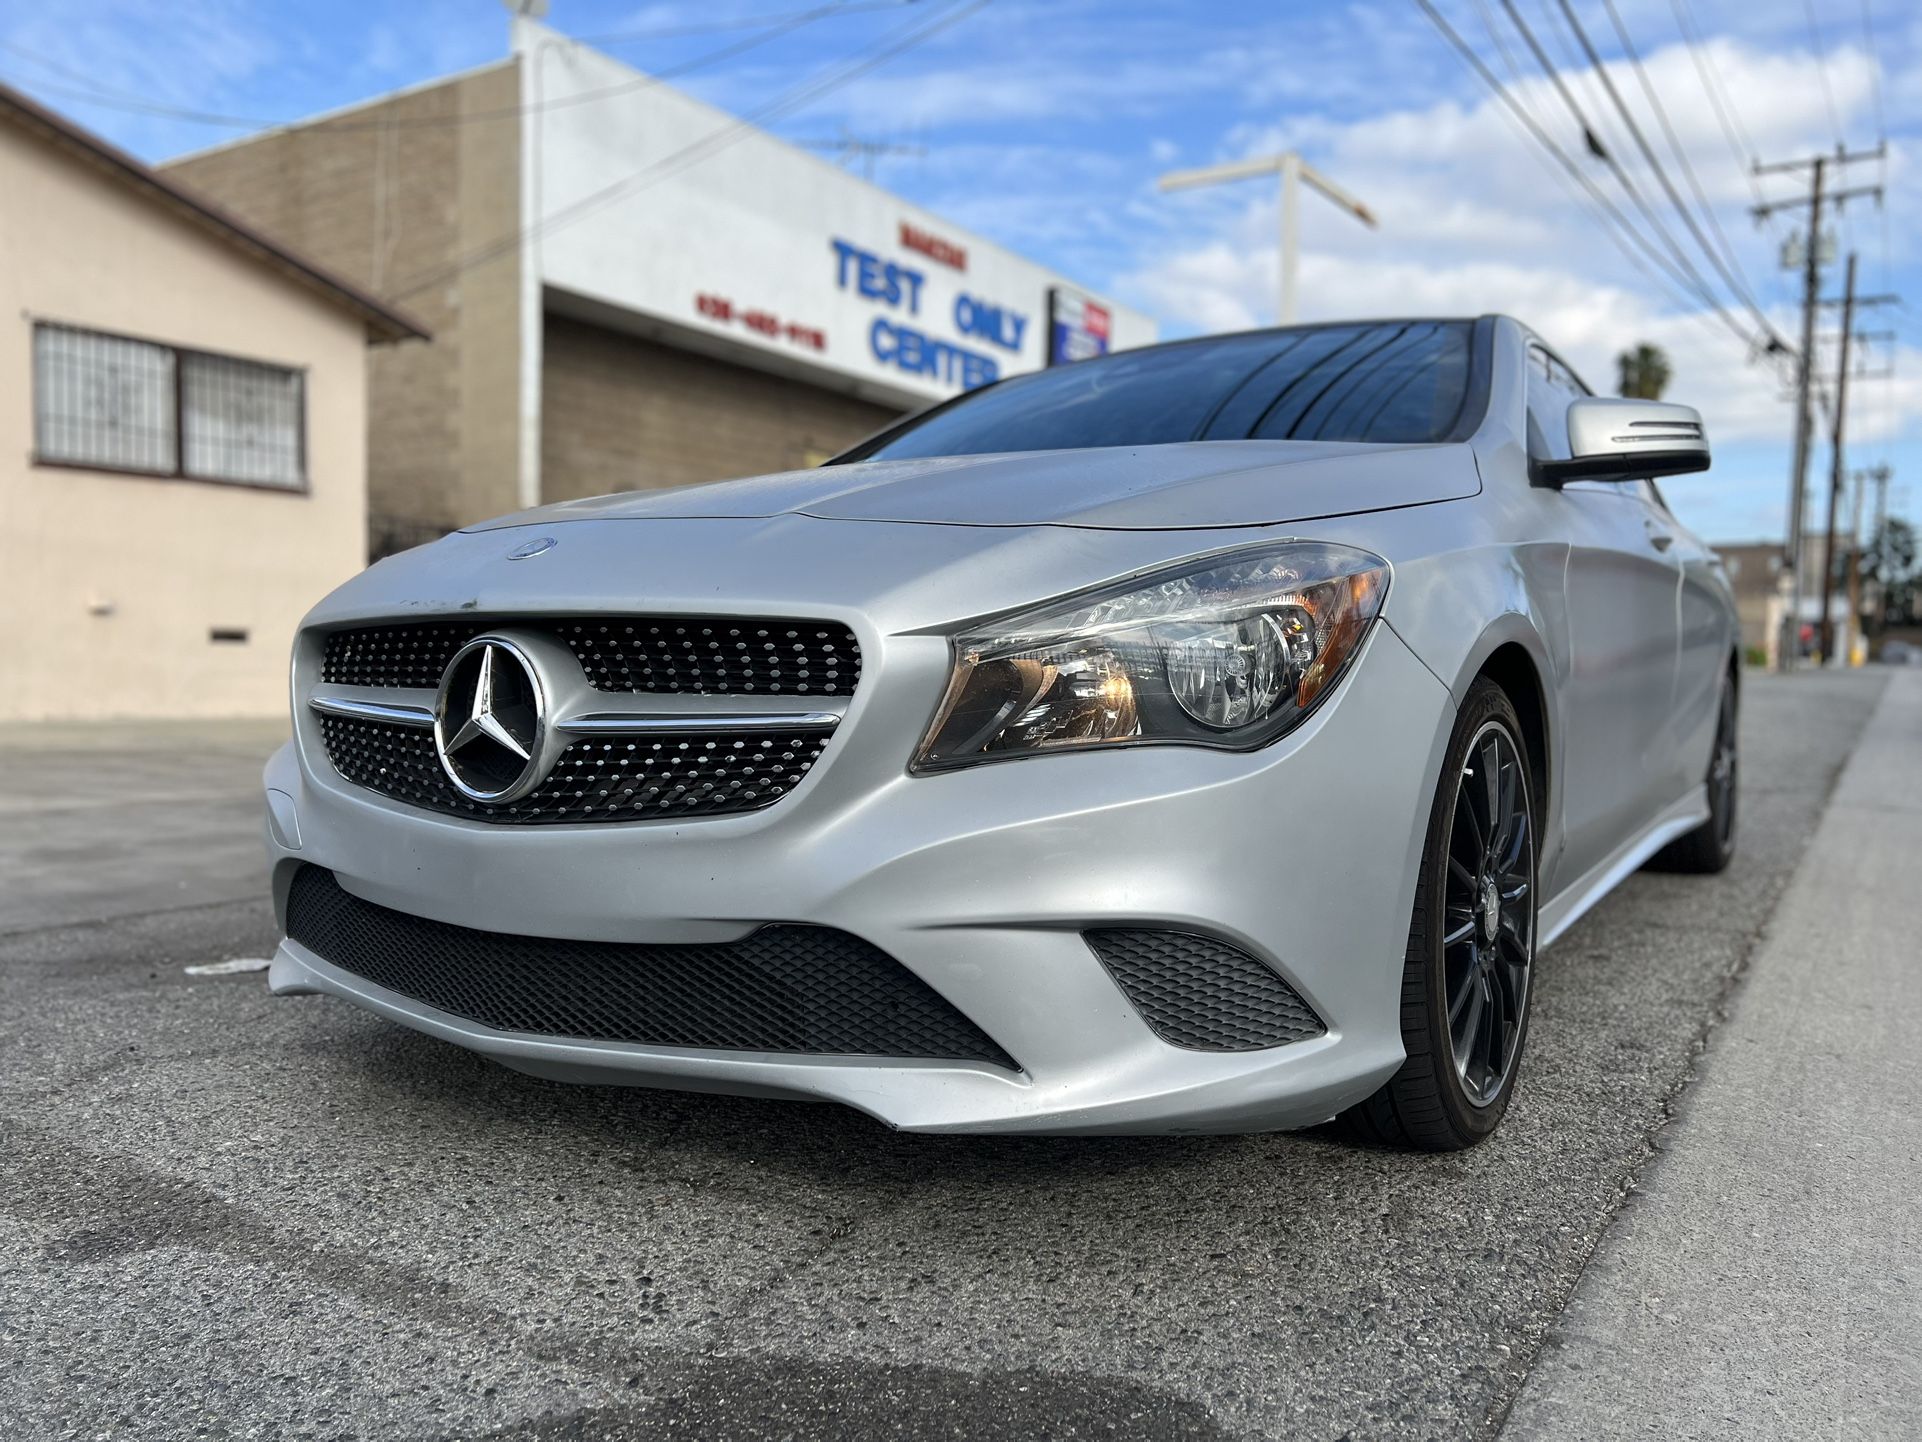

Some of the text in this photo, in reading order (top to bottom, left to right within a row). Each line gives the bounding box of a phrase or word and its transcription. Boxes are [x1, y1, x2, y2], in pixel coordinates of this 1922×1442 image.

[832, 240, 925, 315] TEST
[955, 293, 1028, 352] ONLY
[871, 317, 1000, 390] CENTER
